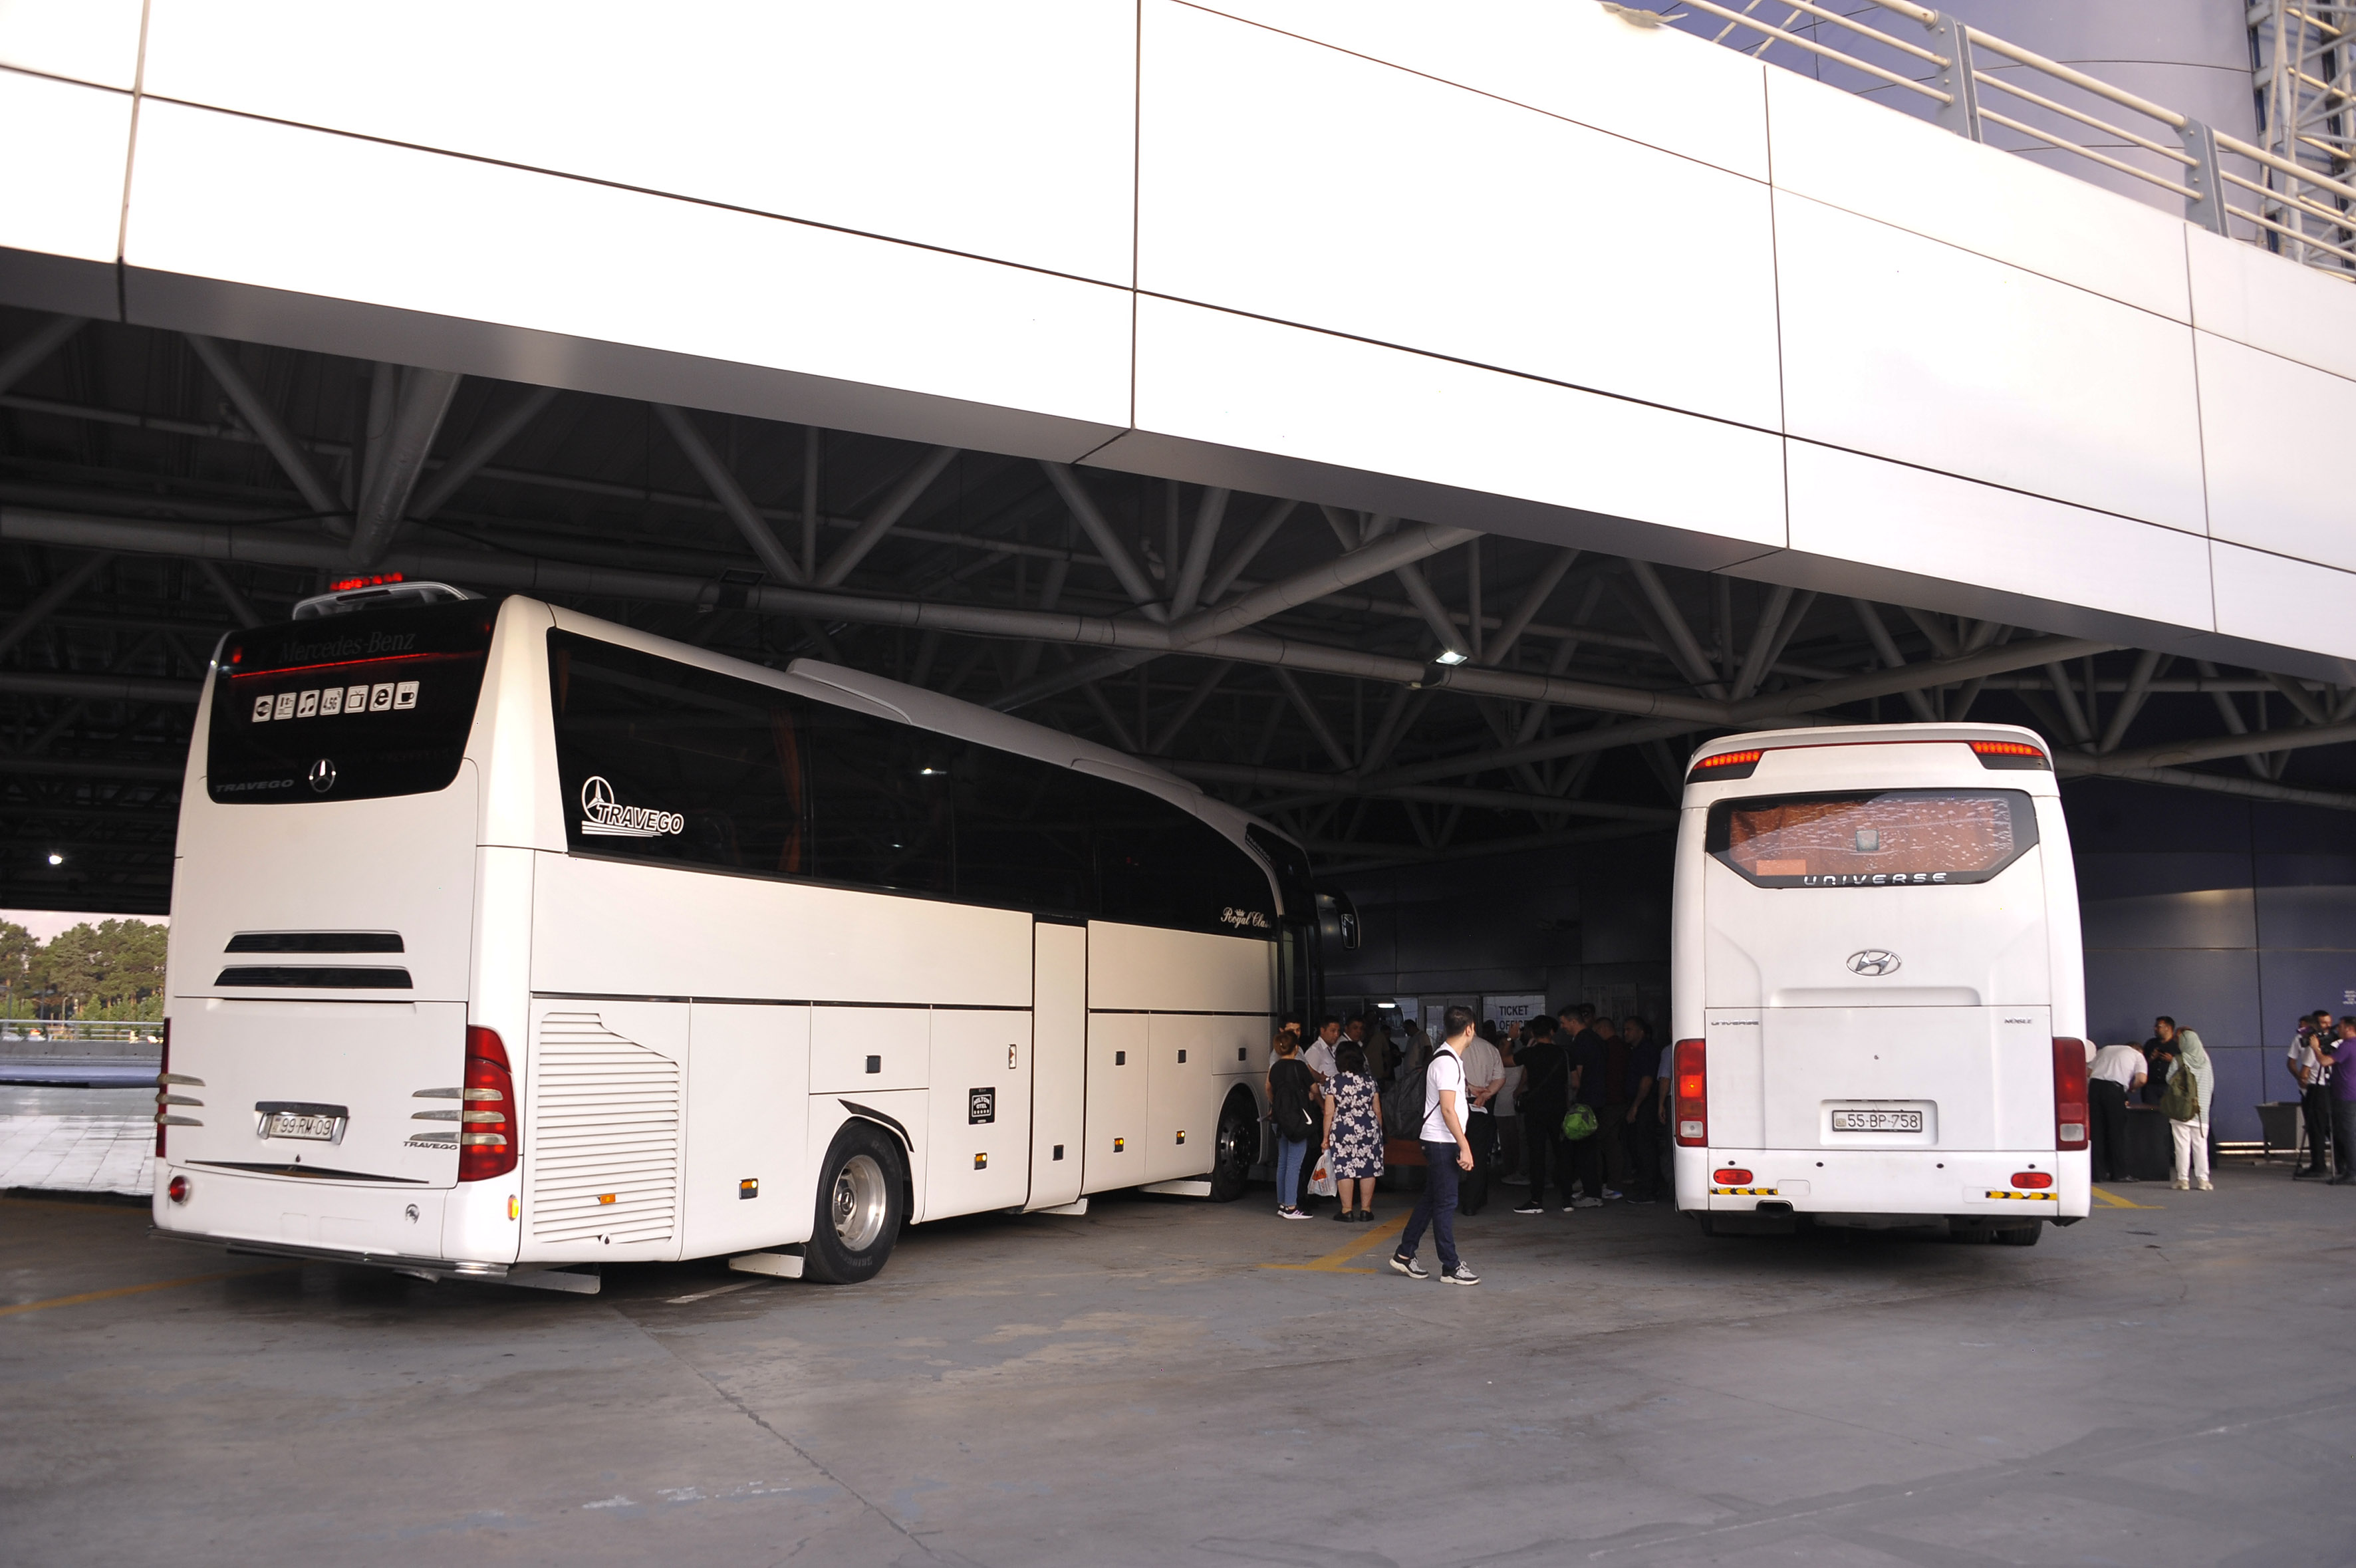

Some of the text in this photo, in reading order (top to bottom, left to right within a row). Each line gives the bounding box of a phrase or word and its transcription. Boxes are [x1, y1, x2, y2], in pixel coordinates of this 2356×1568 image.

[277, 631, 416, 664] Mercedes-Benz
[215, 779, 295, 793] TRAVEGO
[596, 801, 684, 835] TRAVEGO
[1803, 872, 1947, 886] UNIVERSE
[1220, 906, 1252, 930] Royal
[1499, 1005, 1529, 1016] TICKET
[1847, 1114, 1918, 1128] 55-BP-758
[403, 1140, 458, 1150] TRAVEGO
